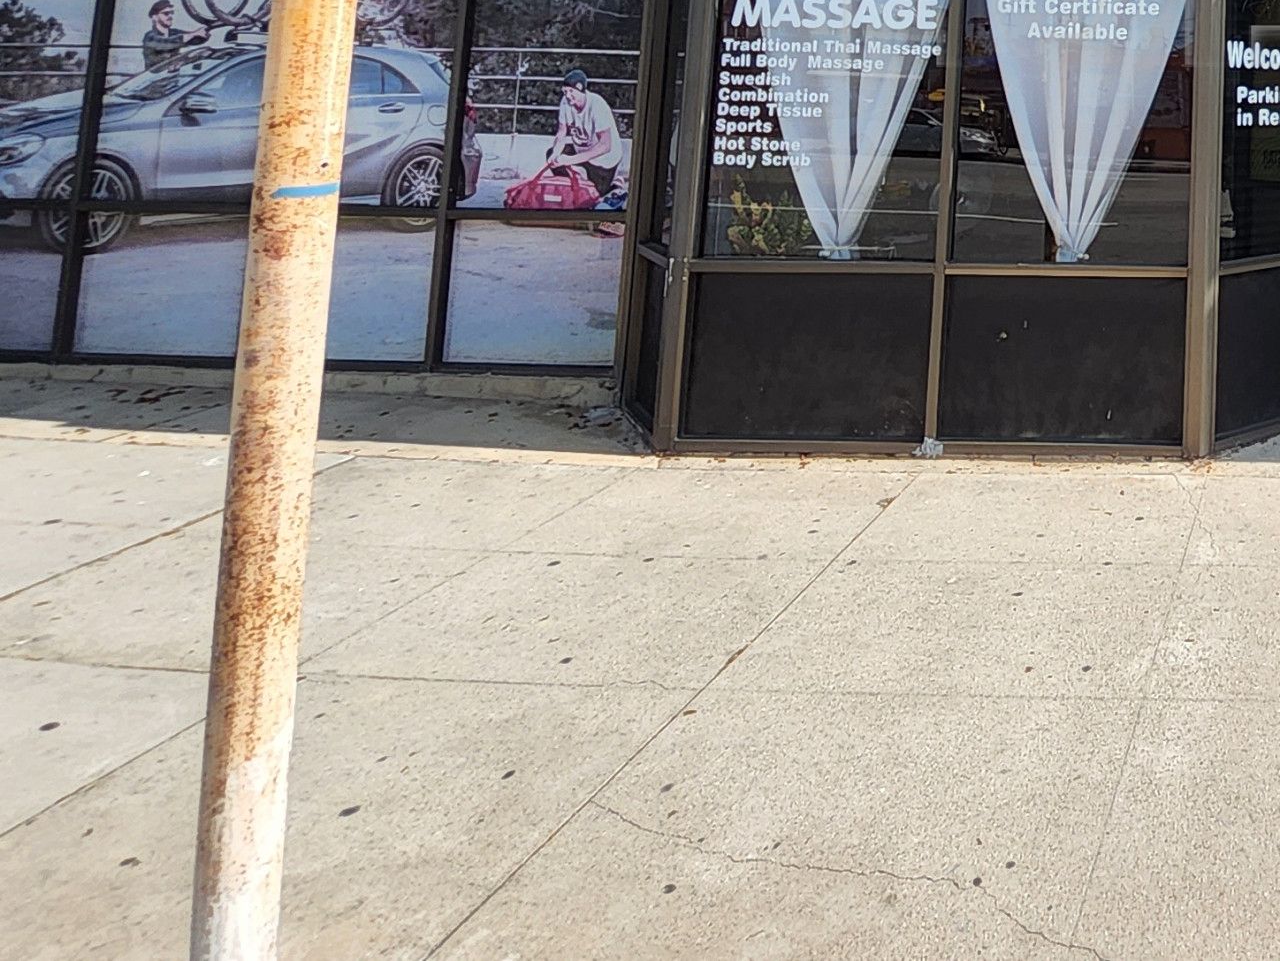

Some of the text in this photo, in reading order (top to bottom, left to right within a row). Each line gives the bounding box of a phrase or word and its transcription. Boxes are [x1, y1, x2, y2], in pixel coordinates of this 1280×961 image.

[1027, 22, 1128, 41] Available
[722, 38, 942, 59] Traditional Thai Massage
[721, 54, 885, 73] Full Body Massage
[719, 72, 791, 86] Swedish
[718, 88, 829, 103] Combination
[717, 103, 823, 119] Deep Tissue
[1236, 107, 1253, 126] in
[715, 119, 772, 134] Sports
[714, 137, 801, 152] Hot Stone
[713, 153, 811, 169] Body Scrub
